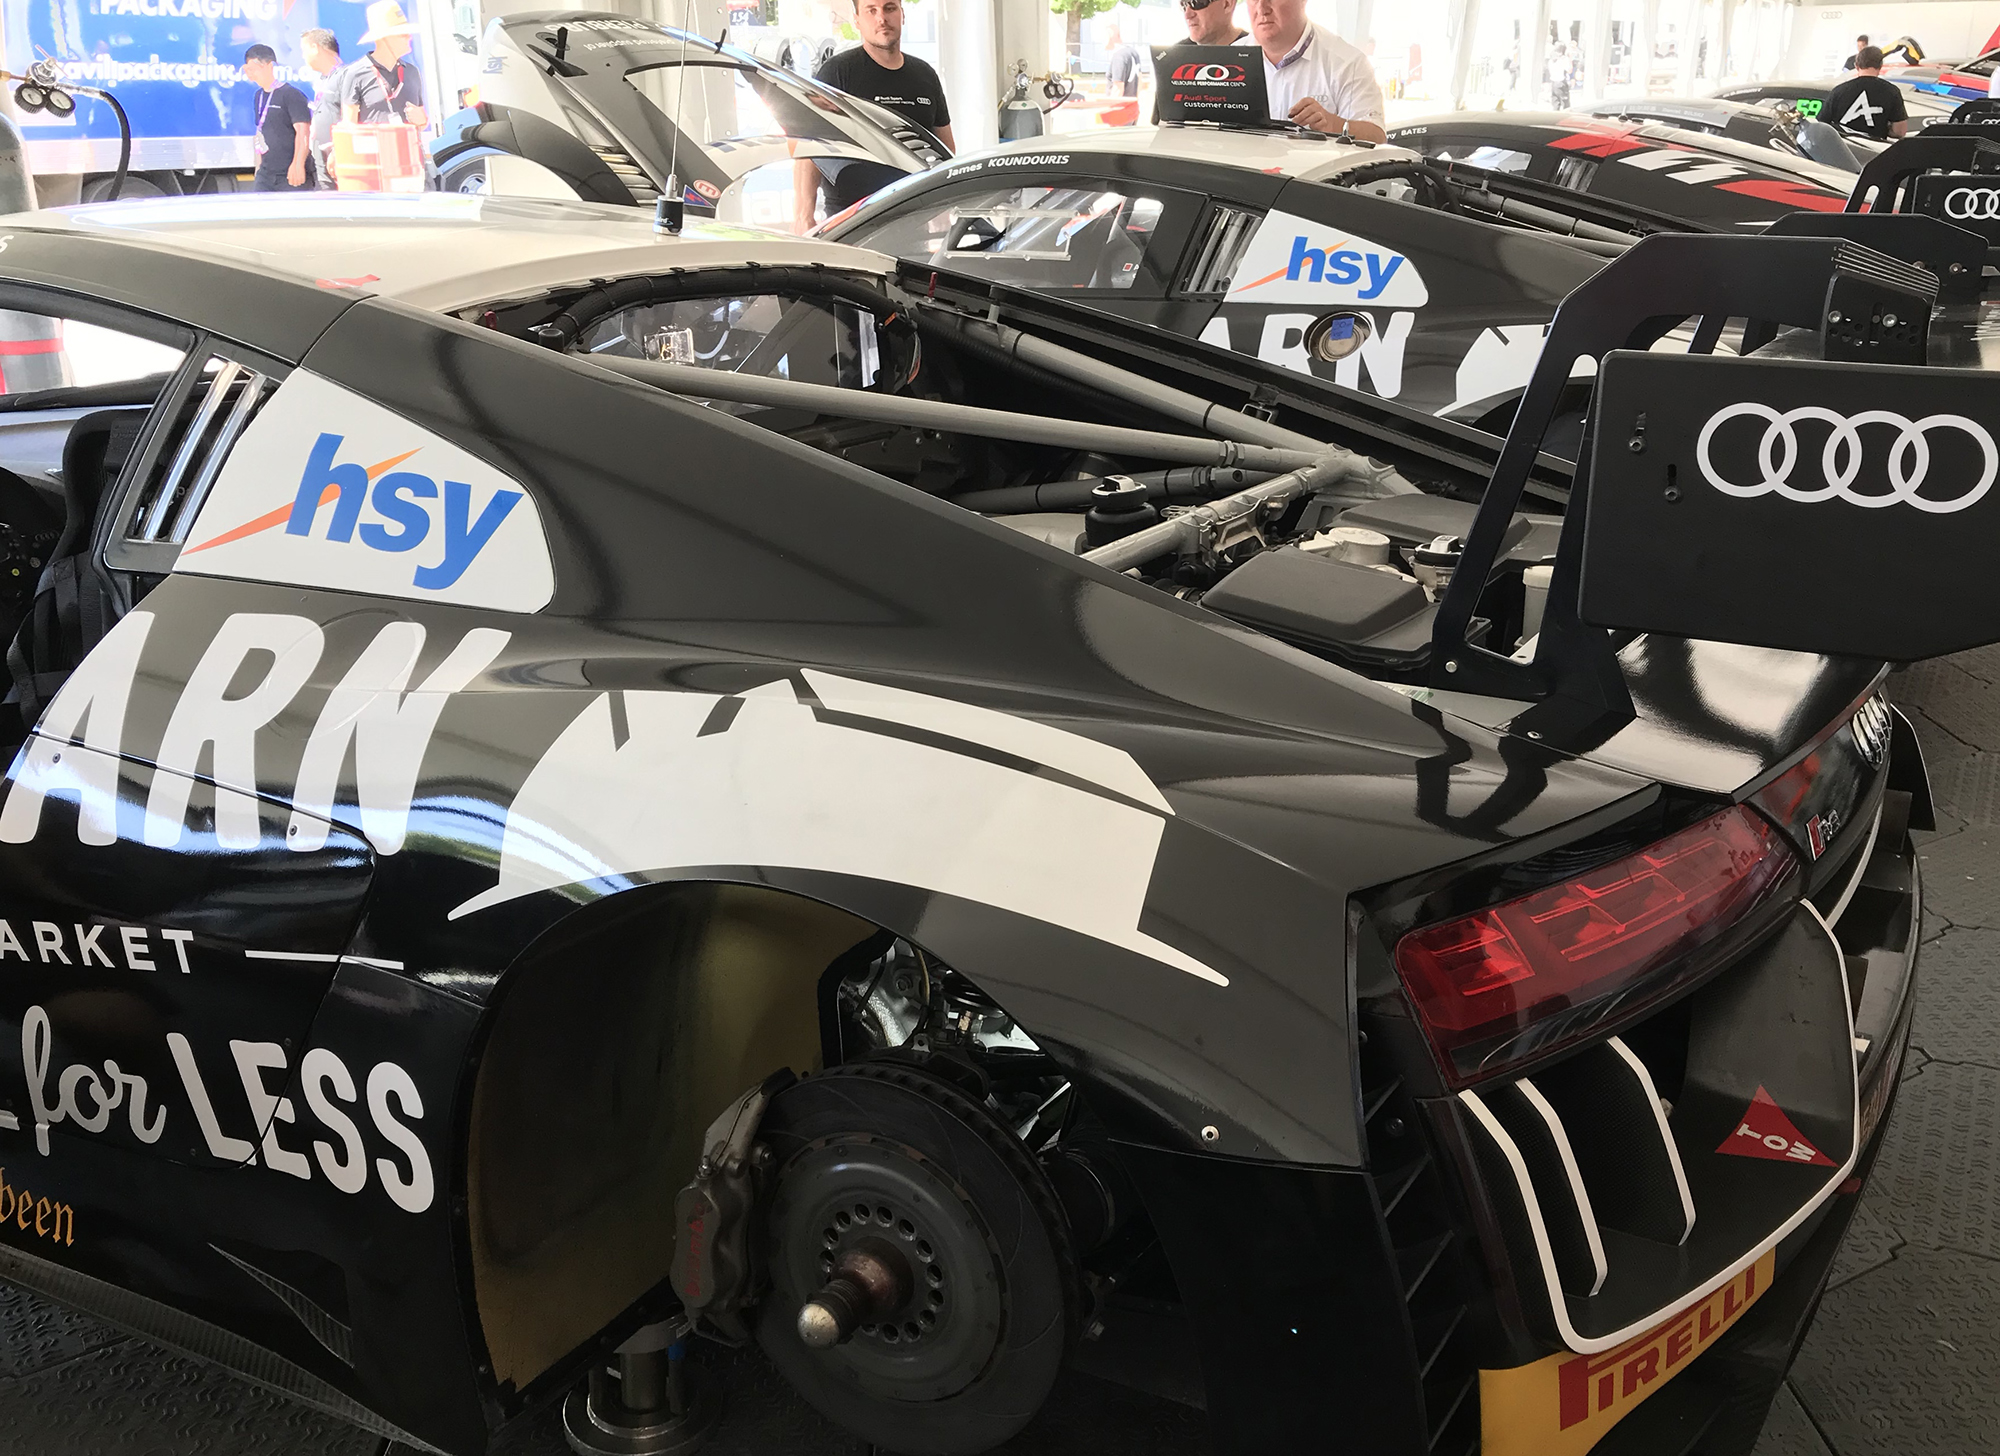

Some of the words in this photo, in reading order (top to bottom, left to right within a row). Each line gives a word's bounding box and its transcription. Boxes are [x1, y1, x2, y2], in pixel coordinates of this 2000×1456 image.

[1183, 101, 1222, 109] customer
[1223, 102, 1250, 111] racing
[1203, 94, 1227, 103] Sport
[1400, 127, 1428, 137] BATES
[947, 162, 983, 179] James
[987, 154, 1070, 168] KOUNDOURIS
[1286, 236, 1405, 300] hsy
[284, 432, 525, 590] hsy
[22, 1005, 167, 1156] for
[166, 1032, 435, 1214] LESS
[1736, 1123, 1817, 1163] TOW
[1558, 1264, 1756, 1432] PIRELLI
